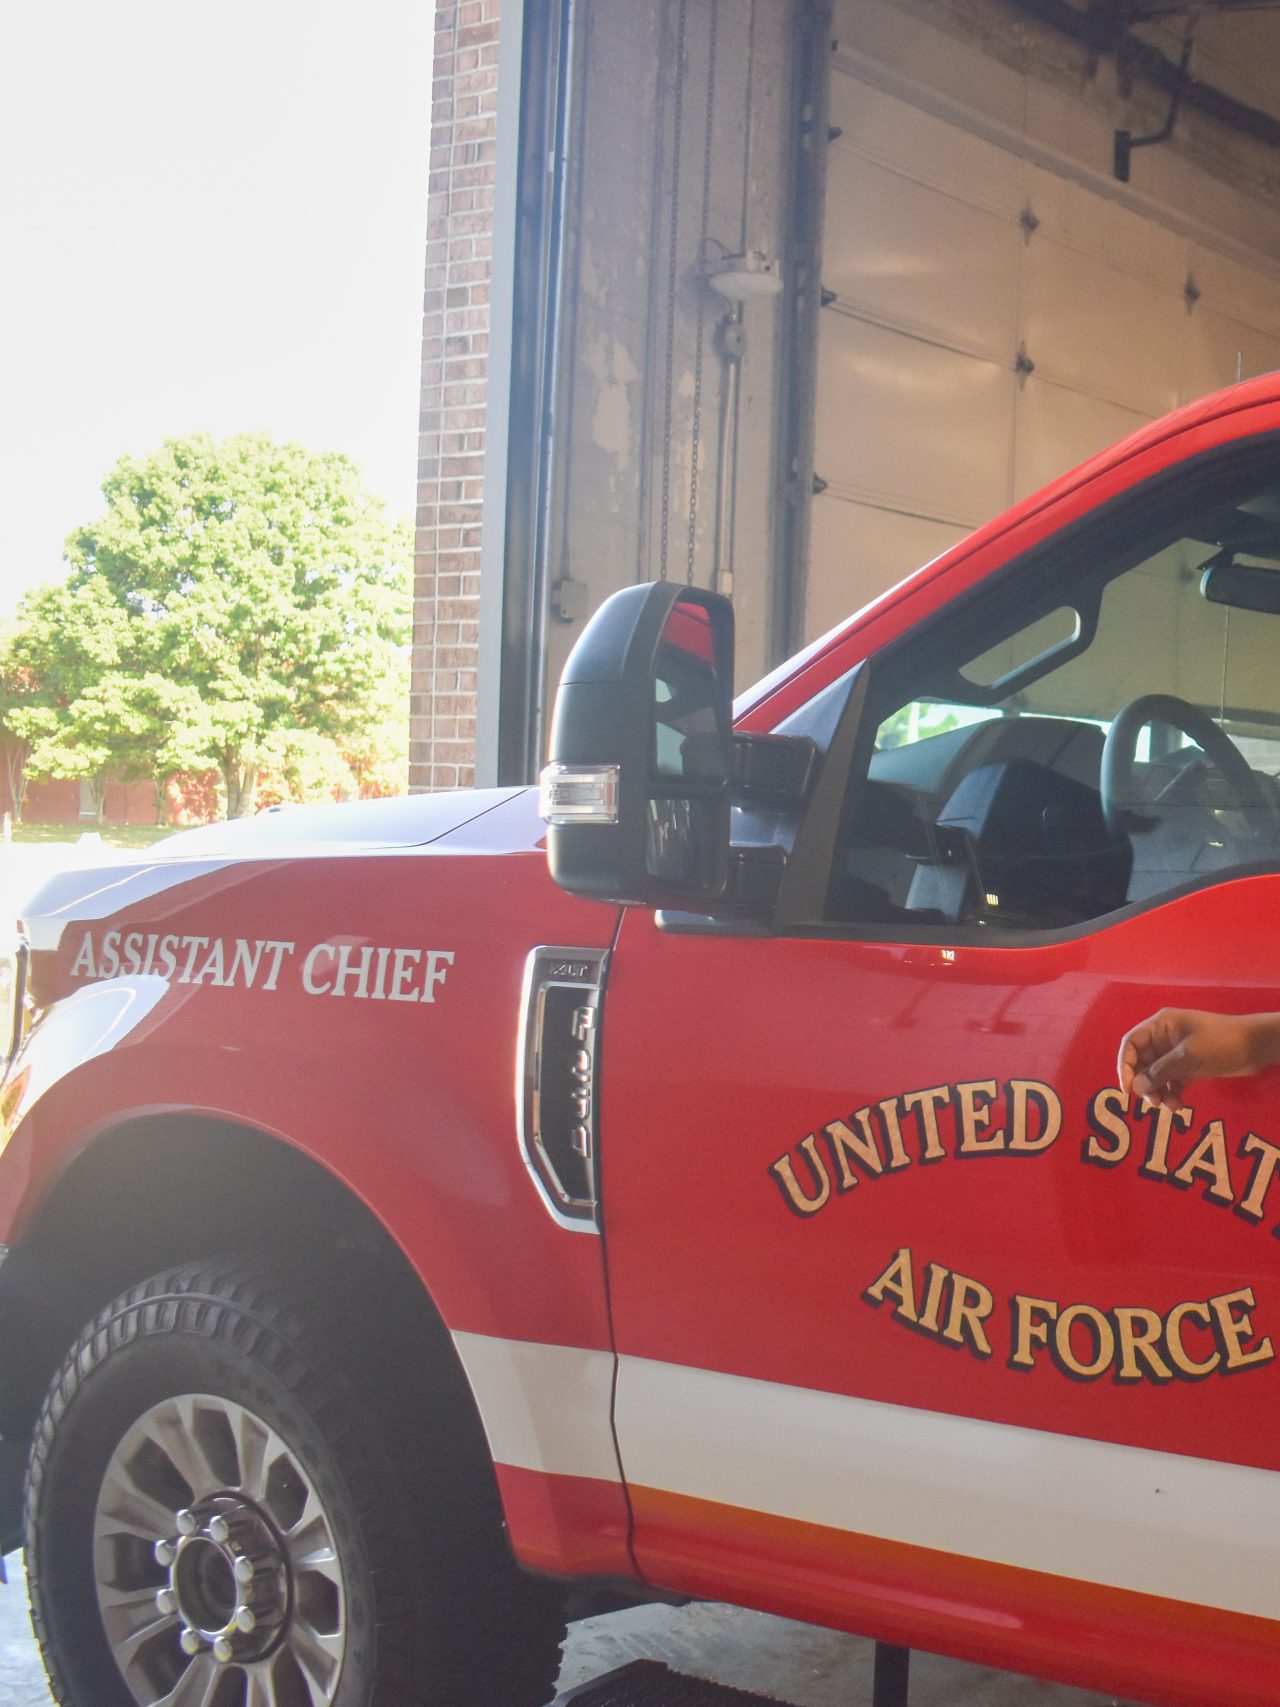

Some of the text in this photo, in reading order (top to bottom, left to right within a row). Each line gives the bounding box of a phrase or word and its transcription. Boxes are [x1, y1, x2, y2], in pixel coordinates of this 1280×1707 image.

[70, 931, 455, 1003] ASSISTANT CHIEF
[768, 1078, 1063, 1219] UNITED
[861, 1247, 1276, 1385] AIR FORCE
